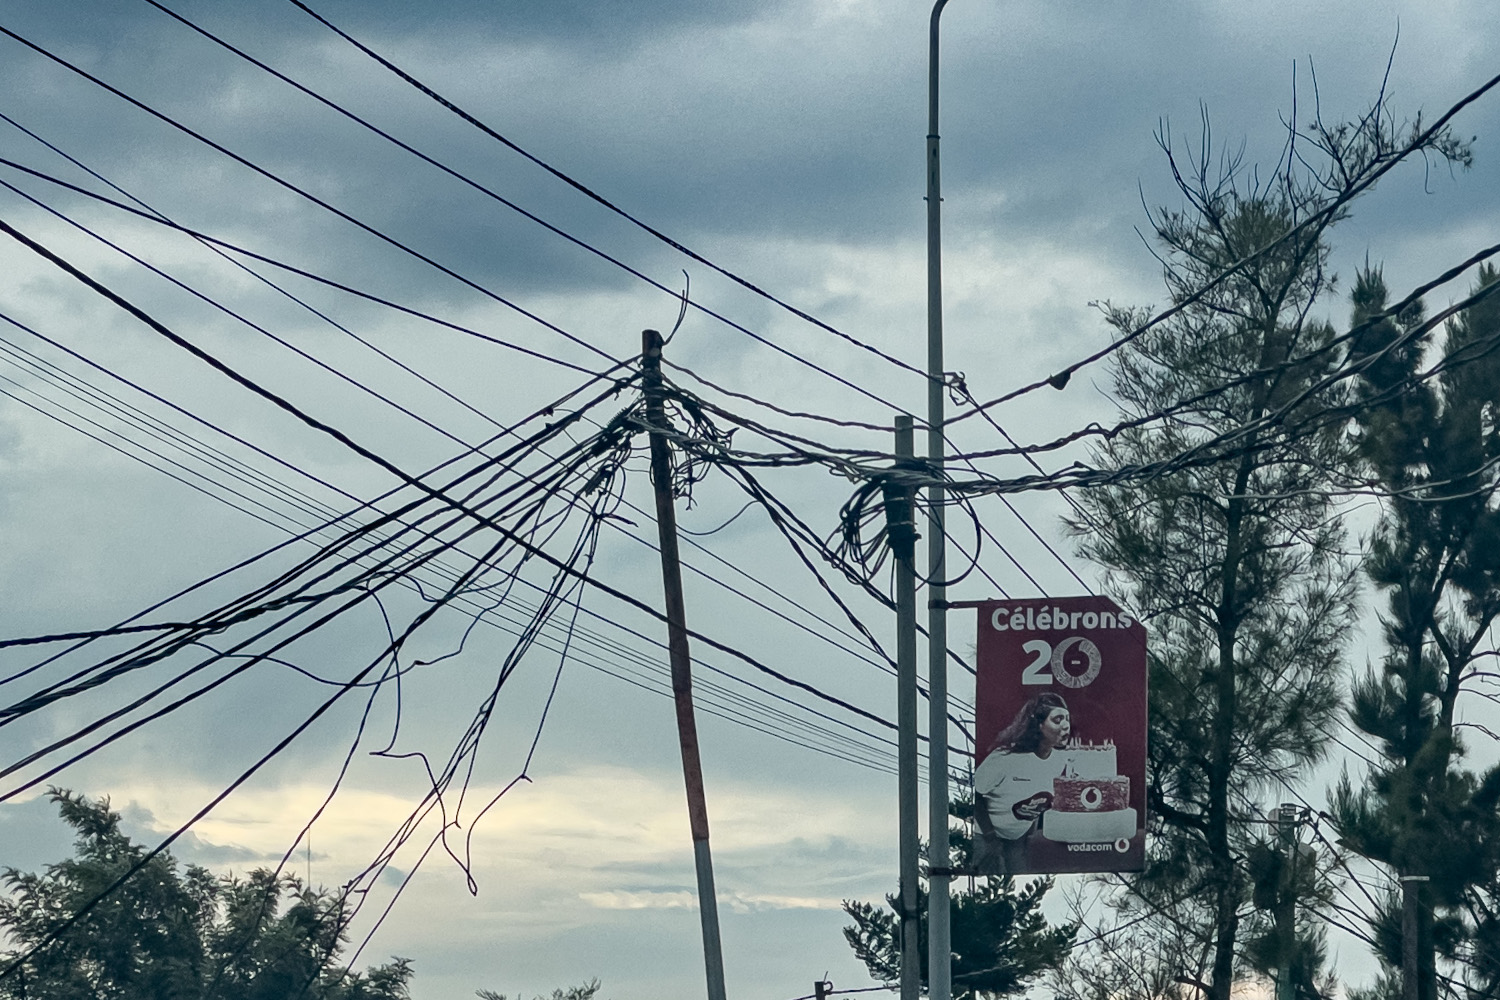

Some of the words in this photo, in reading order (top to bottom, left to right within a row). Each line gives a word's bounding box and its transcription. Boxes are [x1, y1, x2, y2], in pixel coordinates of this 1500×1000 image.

[991, 605, 1132, 631] Célébrons
[1022, 636, 1102, 688] 20
[1067, 842, 1113, 852] vodacom
